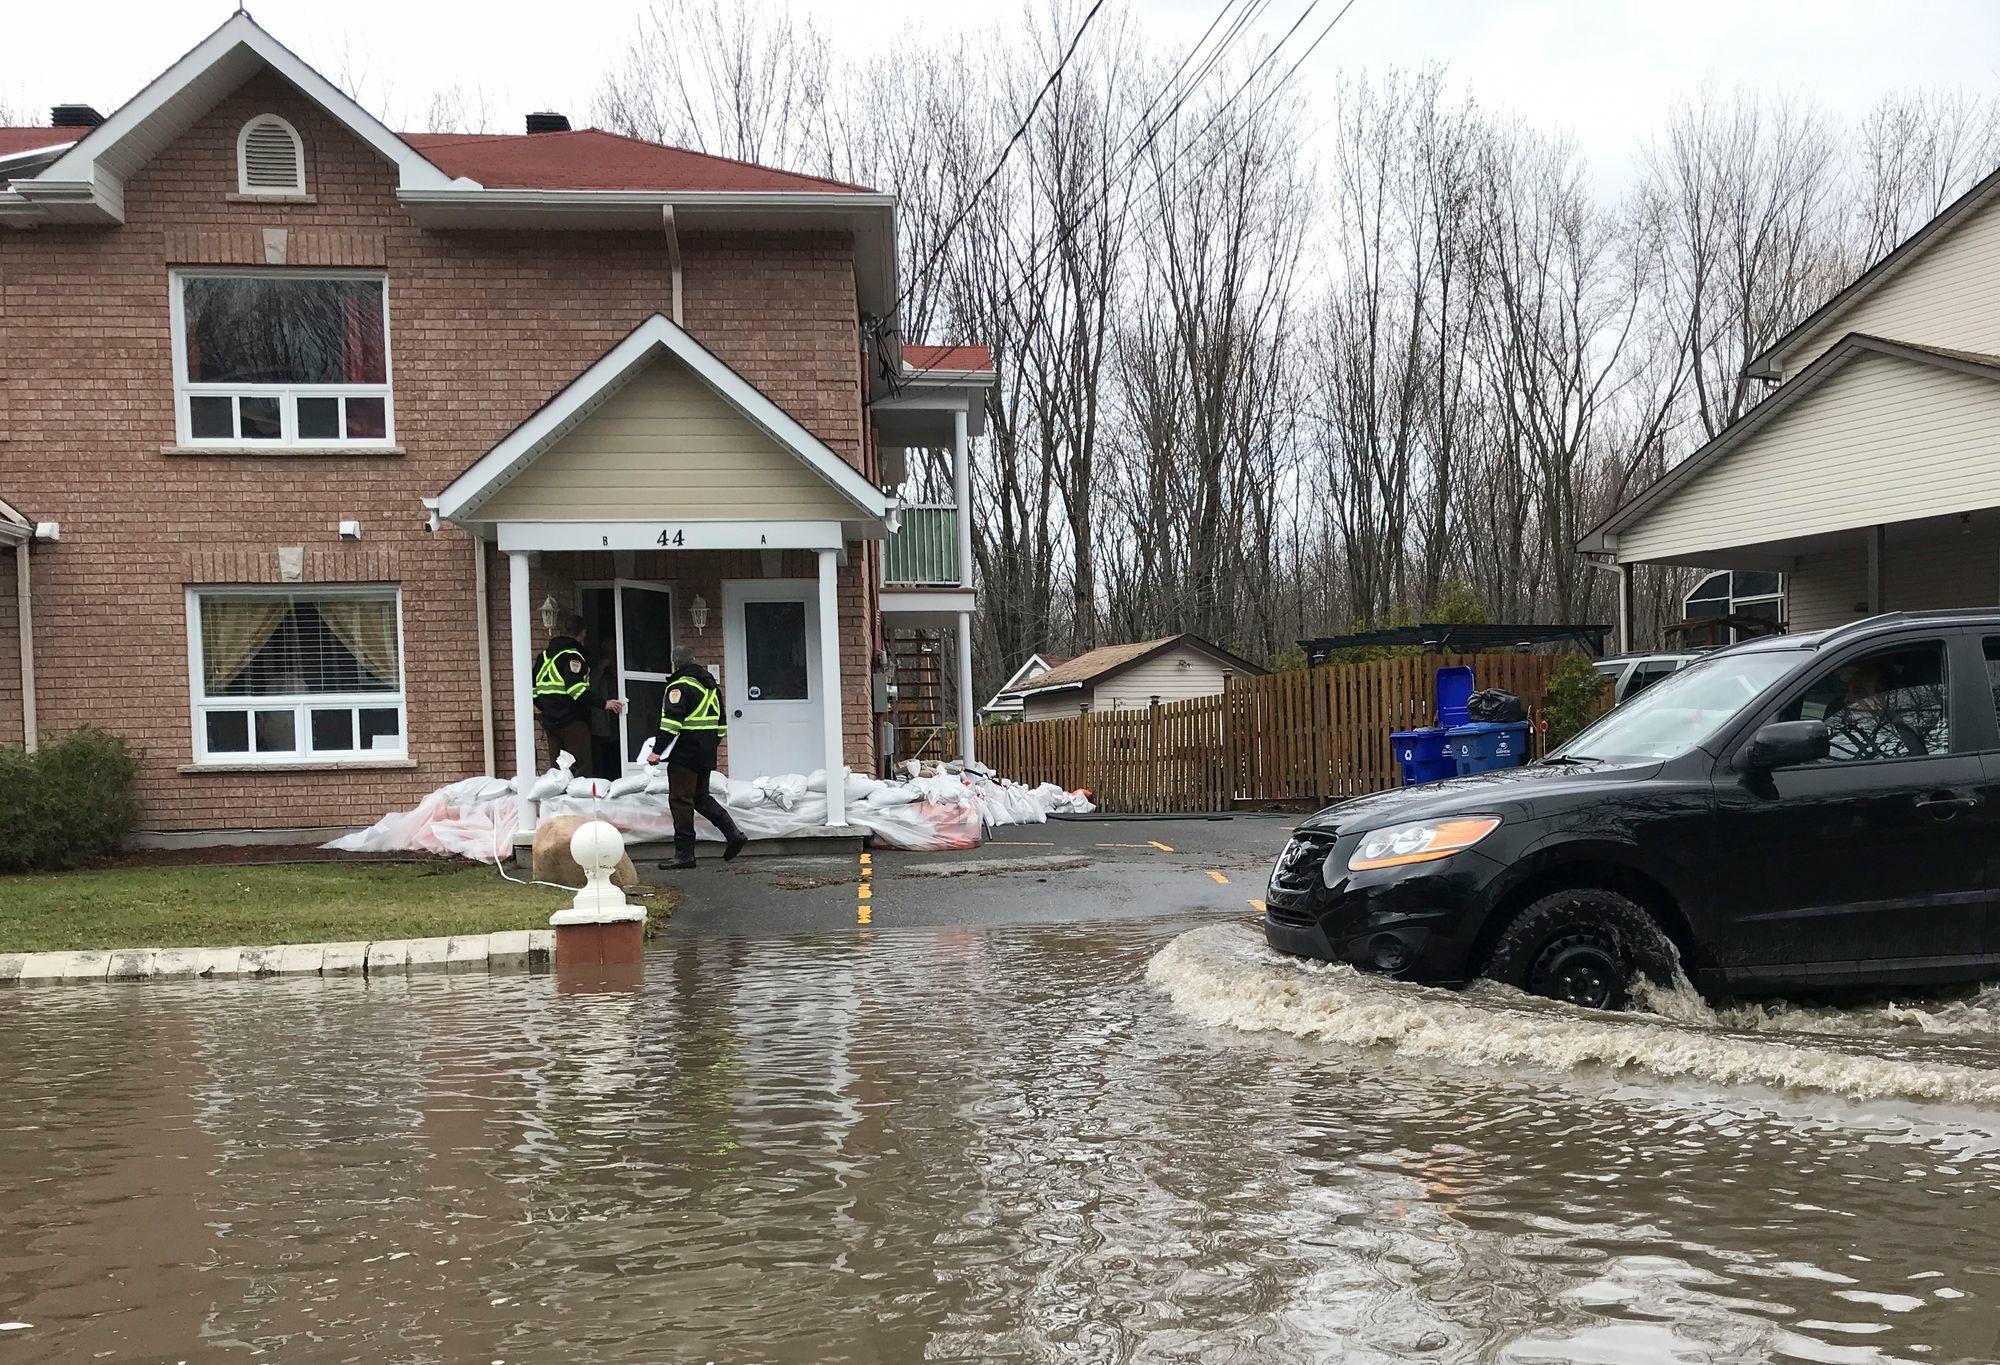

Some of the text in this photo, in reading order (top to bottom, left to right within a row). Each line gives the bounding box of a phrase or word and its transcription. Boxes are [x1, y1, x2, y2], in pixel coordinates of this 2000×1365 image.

[602, 529, 767, 547] B 44 A
